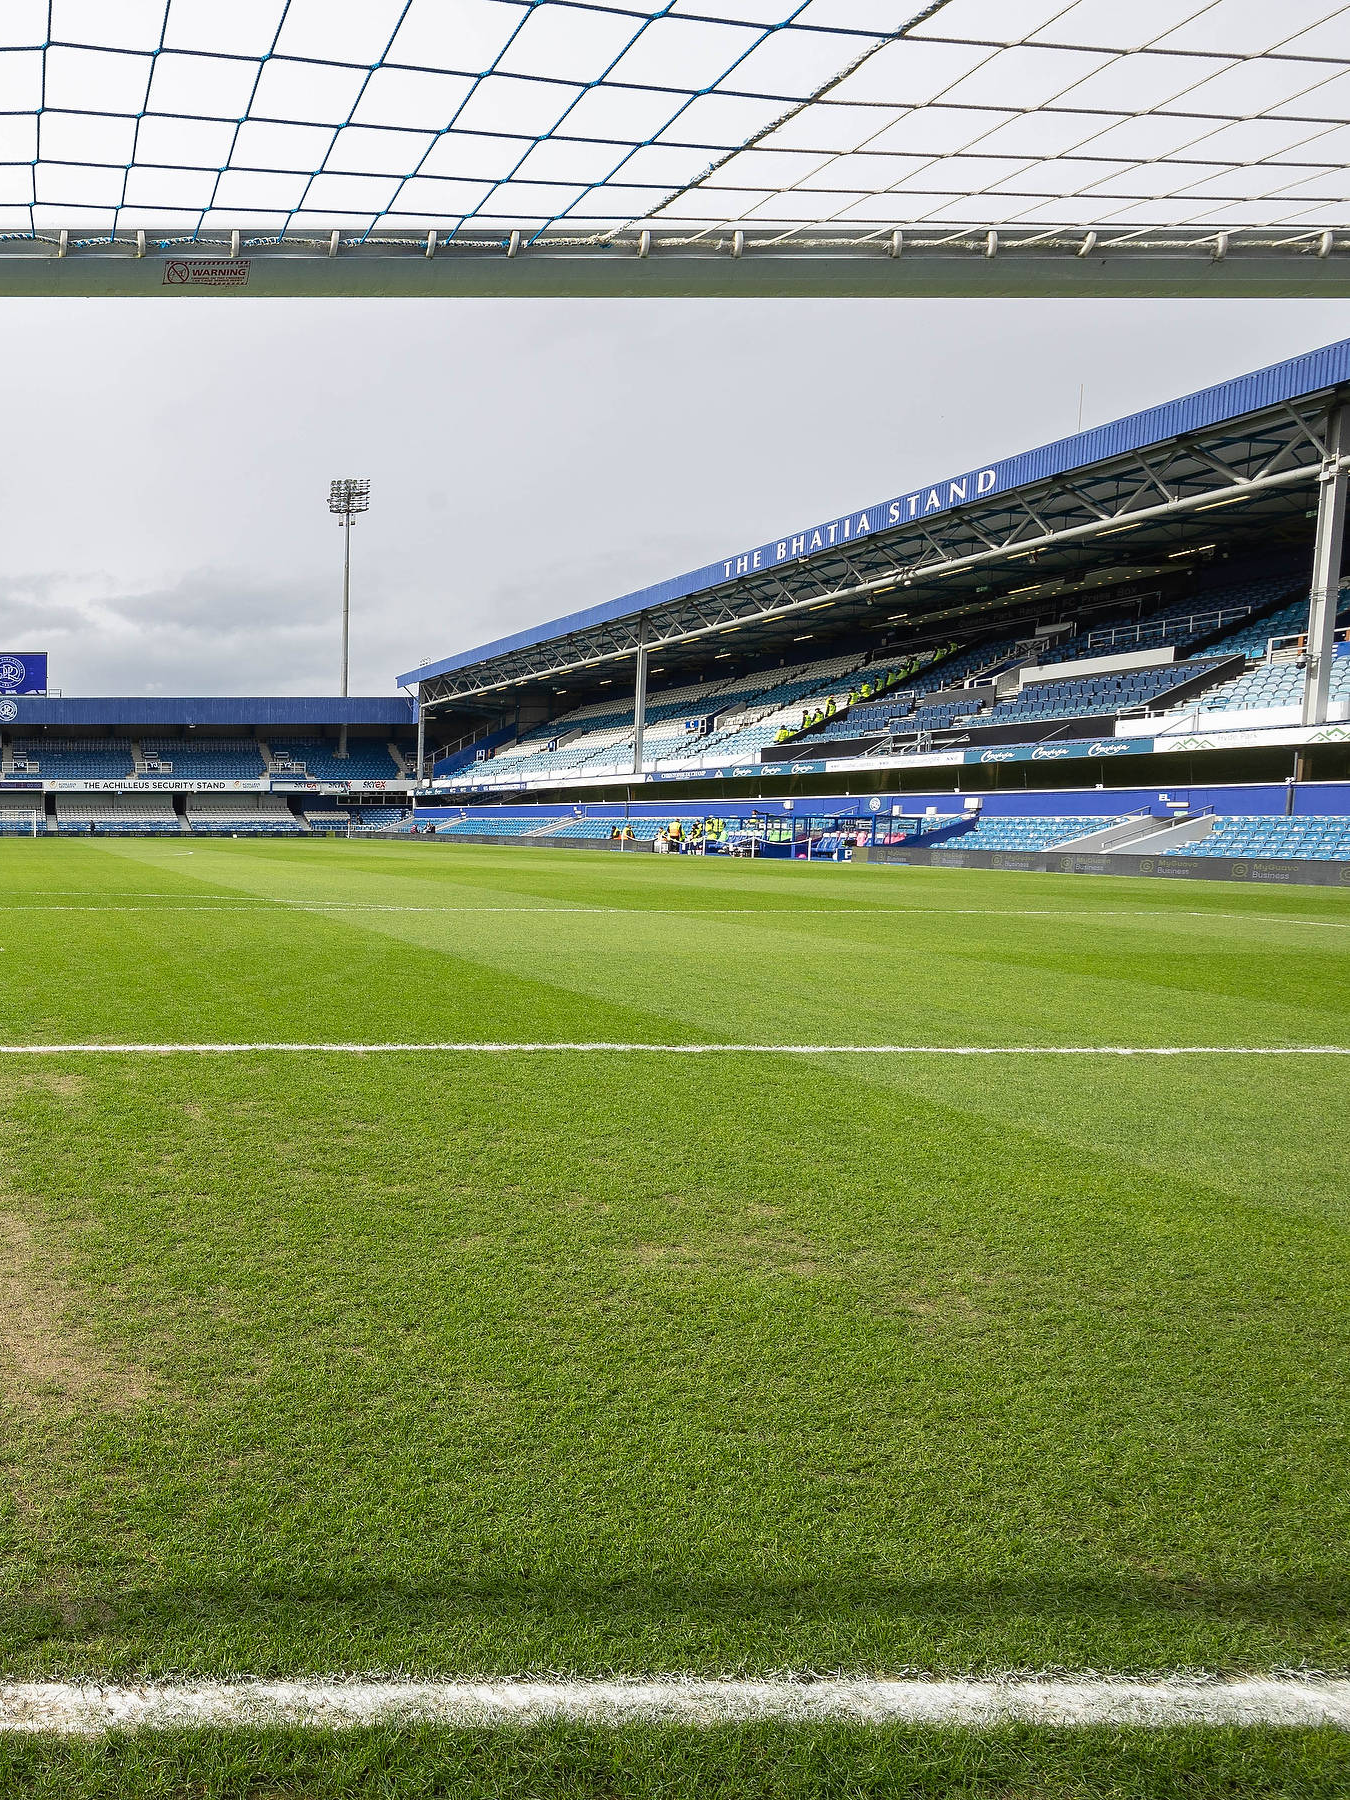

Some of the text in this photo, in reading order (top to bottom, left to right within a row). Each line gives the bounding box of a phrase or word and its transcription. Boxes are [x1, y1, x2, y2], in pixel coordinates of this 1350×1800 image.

[192, 269, 246, 277] WARNING
[723, 469, 997, 578] THE BHATIA STAND
[1031, 747, 1070, 760] Convivia
[1088, 743, 1130, 757] Convivia
[980, 750, 1015, 762] Convivia
[1075, 863, 1104, 871] Business
[1157, 867, 1190, 875] Business
[1253, 863, 1299, 872] MyGuava
[1252, 871, 1290, 880] Business
